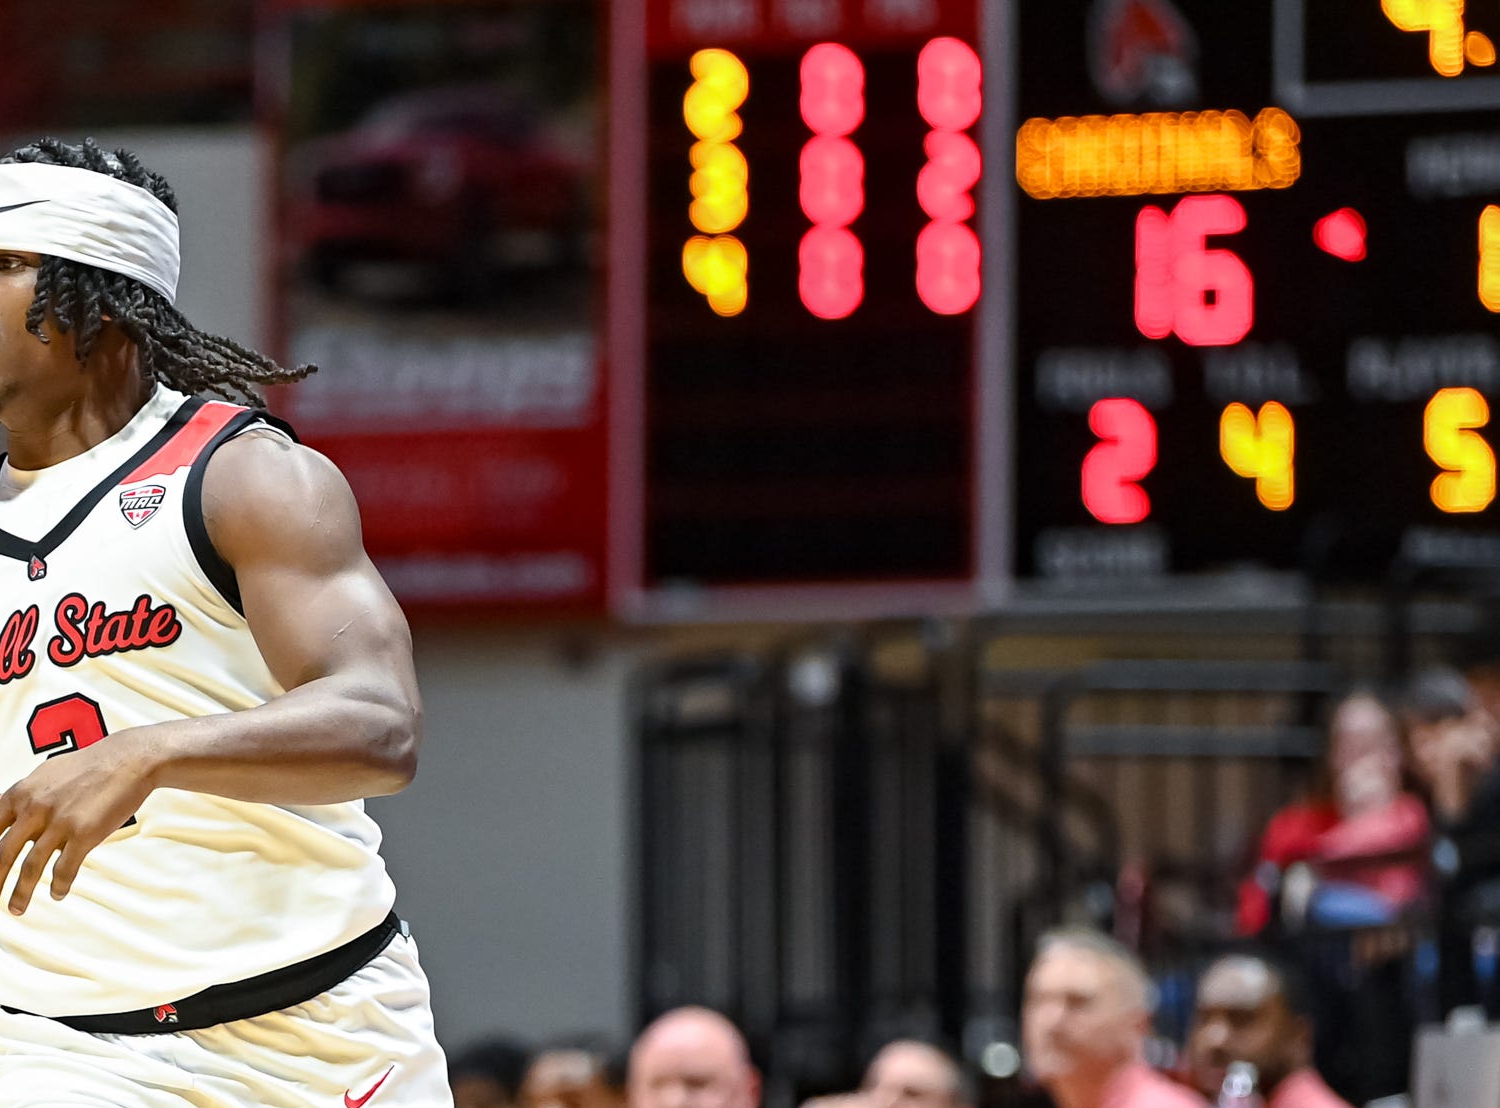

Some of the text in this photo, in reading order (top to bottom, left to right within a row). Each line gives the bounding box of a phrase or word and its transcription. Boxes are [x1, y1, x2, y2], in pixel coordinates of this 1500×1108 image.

[1134, 195, 1255, 346] 16
[120, 494, 165, 511] MAC
[1081, 387, 1497, 524] 2 4 5
[47, 591, 182, 668] State
